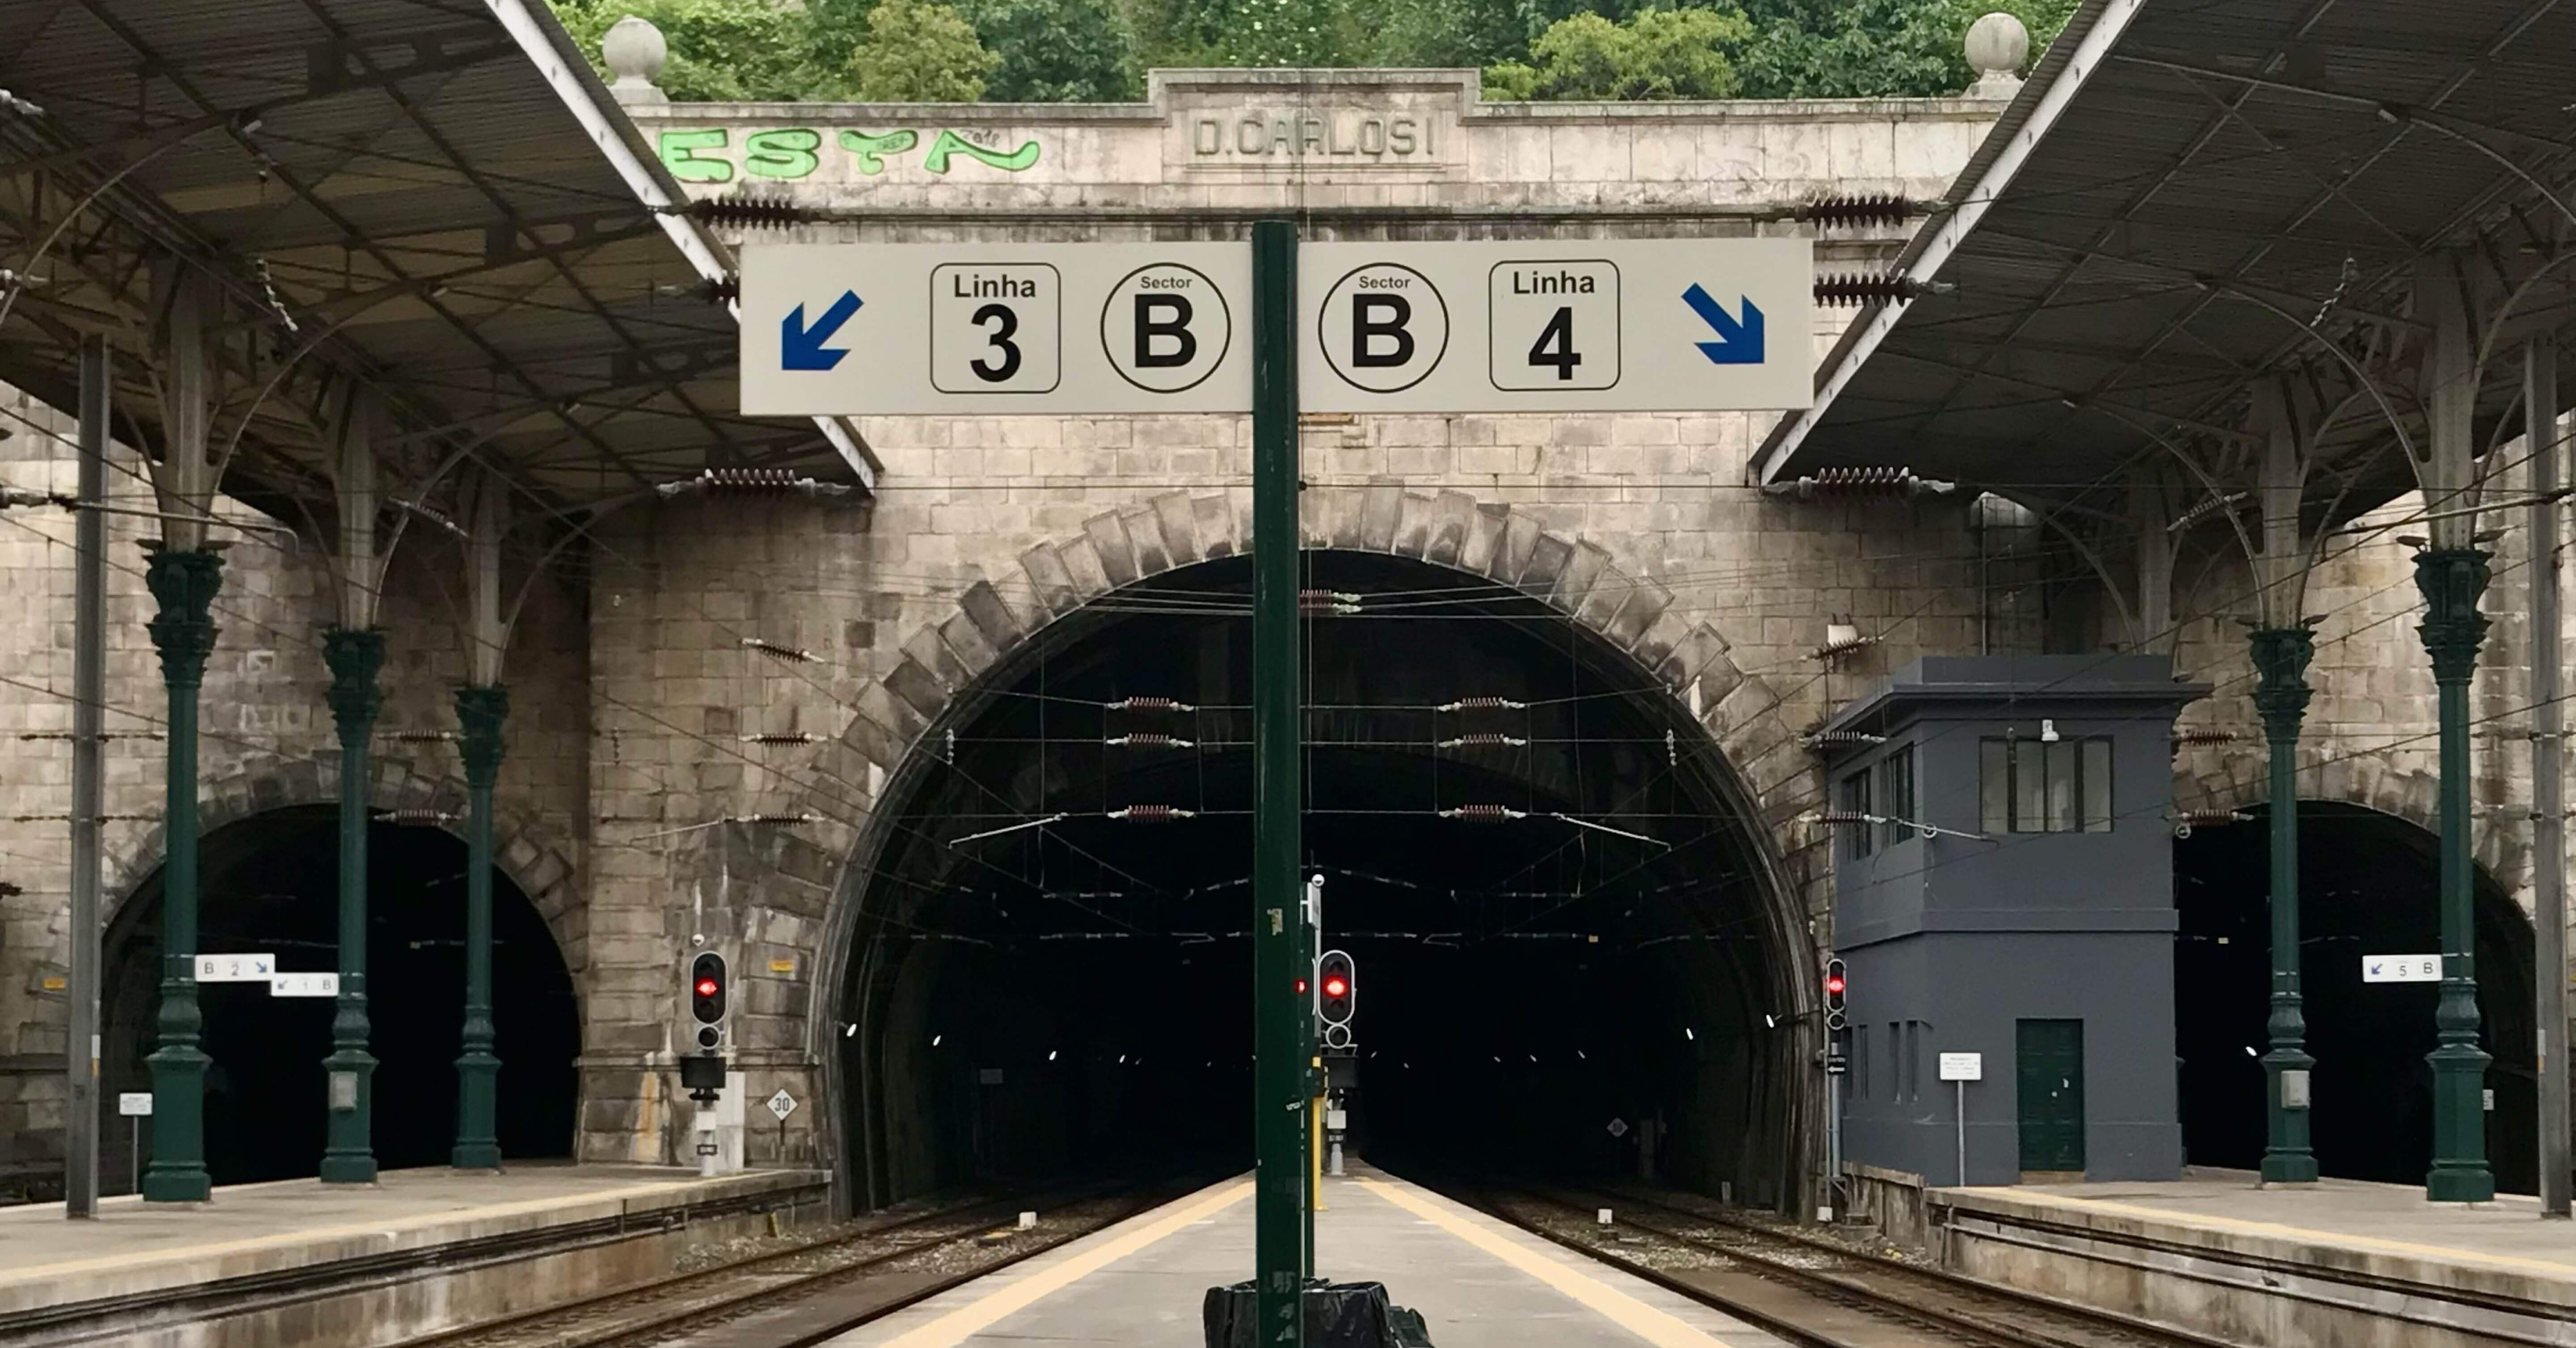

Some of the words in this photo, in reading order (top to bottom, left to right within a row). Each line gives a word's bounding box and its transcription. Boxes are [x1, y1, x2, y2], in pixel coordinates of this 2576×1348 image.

[955, 274, 1036, 298] Linha
[1140, 276, 1192, 289] Sector
[1359, 276, 1411, 289] Sector
[1513, 271, 1595, 294] Linha
[1135, 294, 1197, 368] B
[1353, 293, 1415, 368] B
[970, 304, 1021, 382] 3
[1529, 307, 1581, 380] 4
[204, 962, 214, 974] B
[231, 964, 239, 976] 2
[2399, 965, 2407, 977] 5
[2423, 962, 2433, 974] B
[322, 979, 331, 990] B
[775, 1098, 790, 1112] 30
